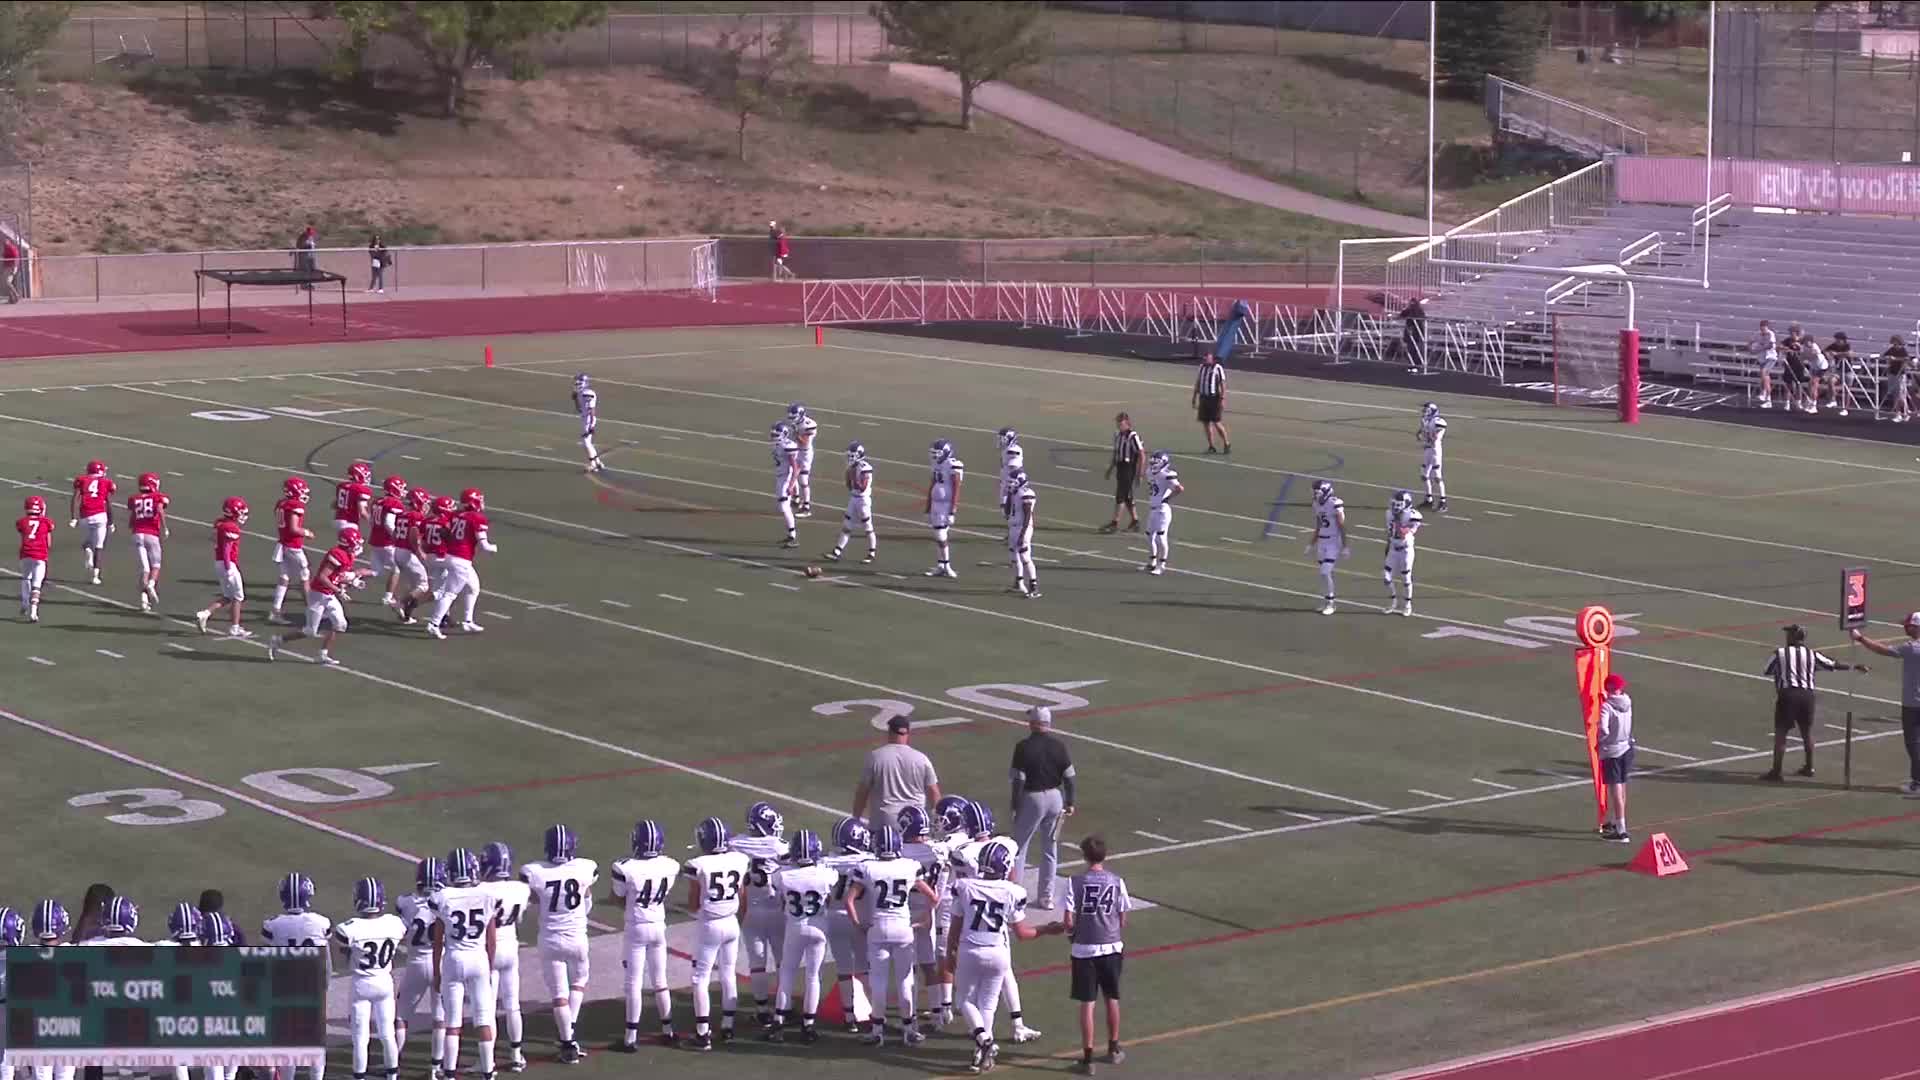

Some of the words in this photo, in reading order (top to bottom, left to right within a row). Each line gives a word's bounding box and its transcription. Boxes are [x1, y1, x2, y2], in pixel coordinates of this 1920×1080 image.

[87, 479, 99, 498] 4
[135, 499, 154, 519] 28
[28, 519, 40, 539] 7
[425, 523, 442, 545] 75
[1847, 575, 1865, 606] 3
[67, 767, 396, 825] 30
[1655, 839, 1677, 866] 20
[545, 878, 581, 912] 78
[636, 877, 668, 908] 44
[709, 870, 740, 902] 53
[875, 879, 908, 909] 25
[1082, 883, 1114, 914] 54
[786, 890, 821, 917] 33
[970, 899, 1004, 932] 75
[450, 908, 485, 940] 35
[361, 939, 395, 969] 30
